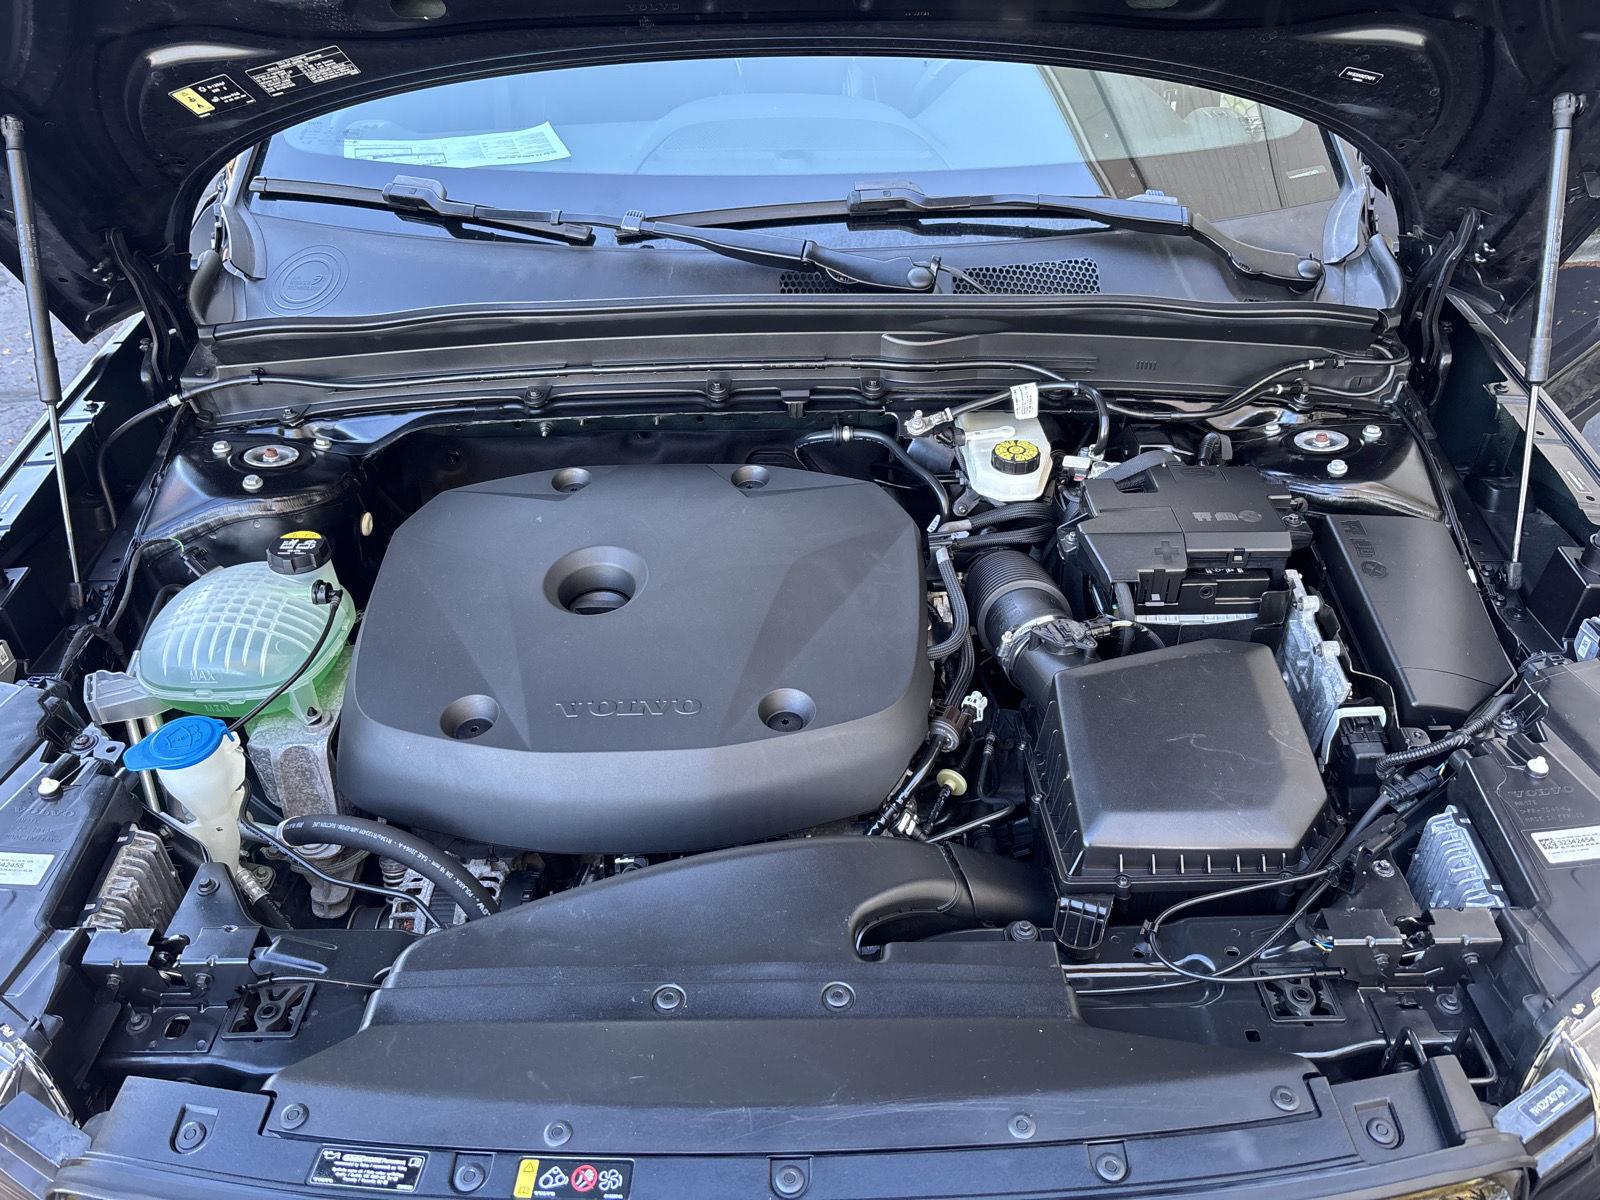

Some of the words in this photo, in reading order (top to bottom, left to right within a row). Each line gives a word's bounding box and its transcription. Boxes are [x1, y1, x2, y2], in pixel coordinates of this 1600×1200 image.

[190, 669, 216, 681] MAX
[555, 698, 703, 718] VOLVO
[1507, 786, 1575, 799] VOLVO
